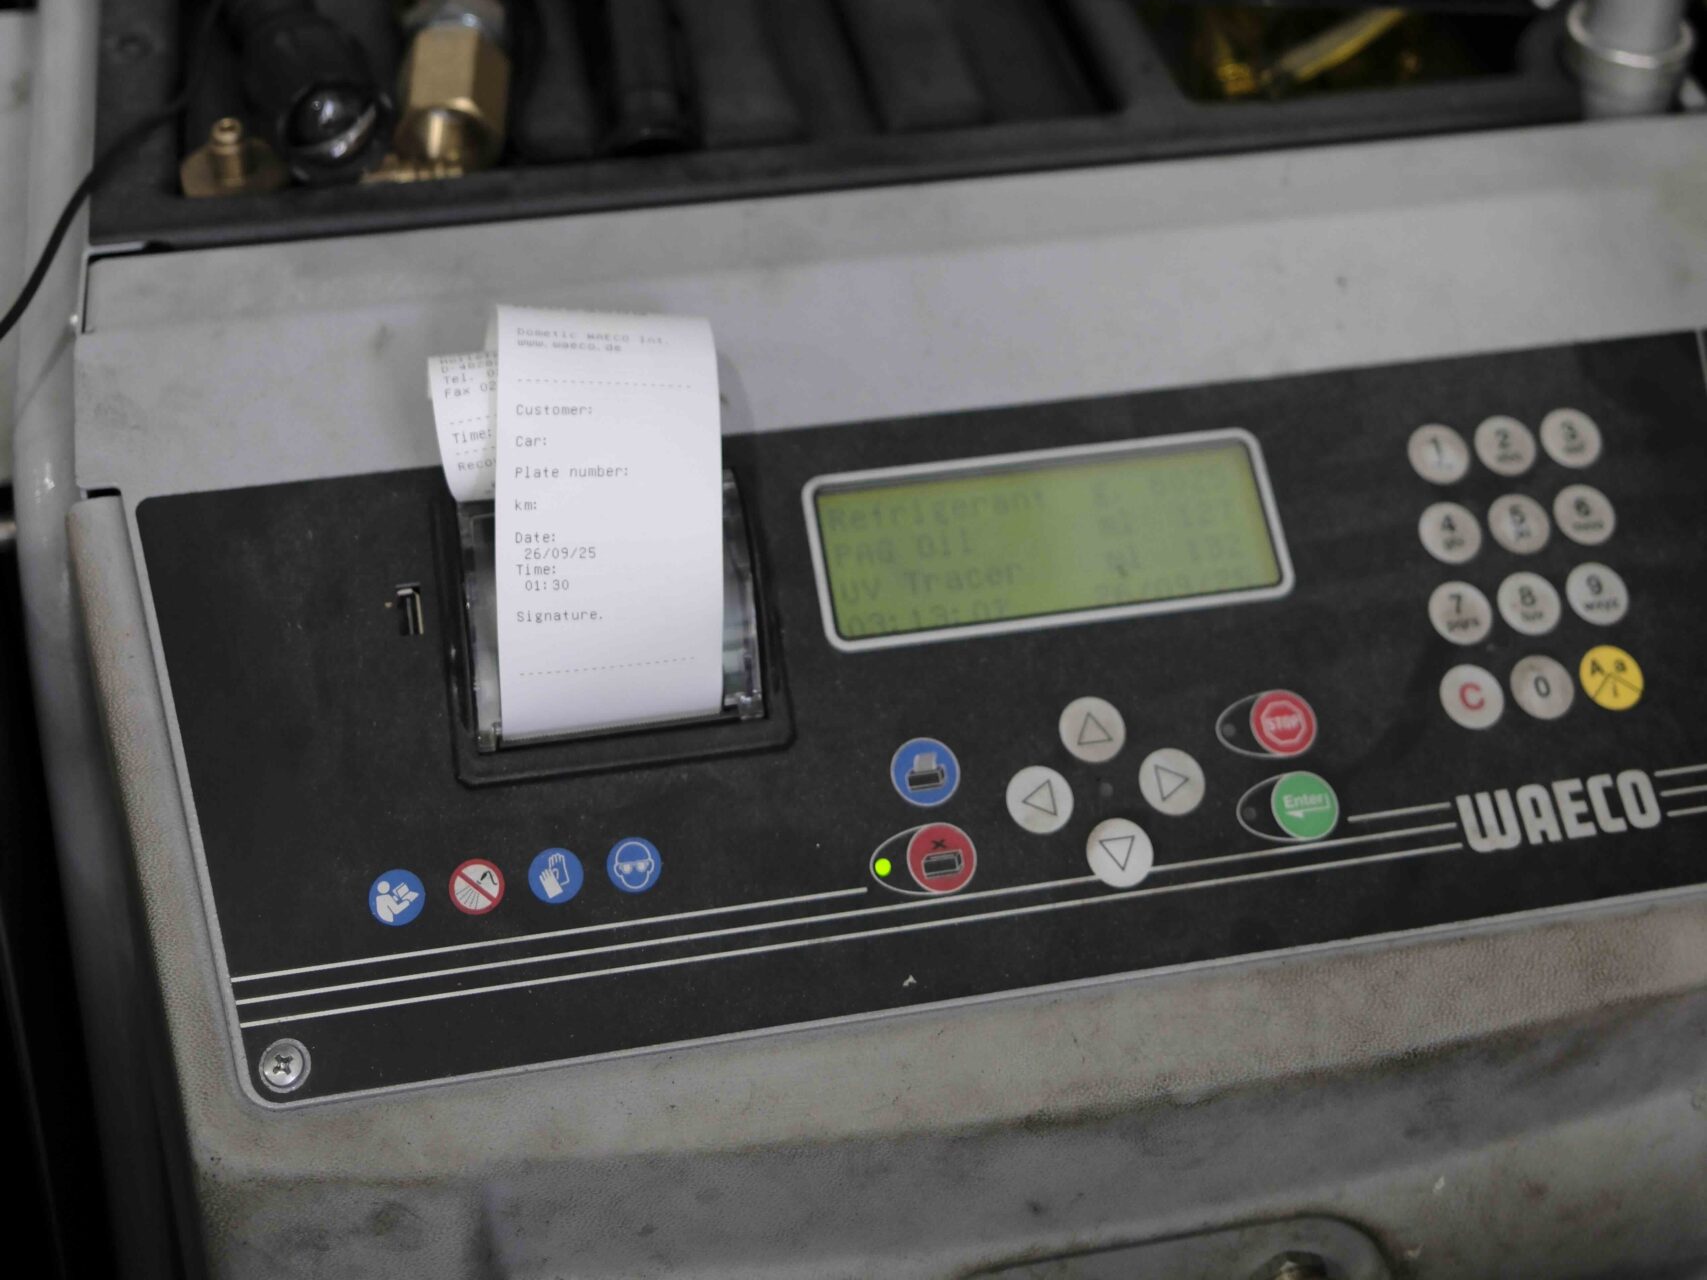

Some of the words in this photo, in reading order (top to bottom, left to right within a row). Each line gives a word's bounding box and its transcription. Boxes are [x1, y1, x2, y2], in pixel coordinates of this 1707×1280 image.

[443, 386, 471, 400] Fax
[515, 403, 593, 416] Customer:
[452, 427, 492, 444] Time:
[515, 435, 547, 447] Car:
[1494, 427, 1510, 450] 2
[514, 466, 560, 479] Plate
[569, 465, 629, 478] number:
[514, 499, 537, 512] km:
[828, 489, 1045, 532] Refrigerant
[1441, 513, 1456, 532] 4
[514, 531, 556, 544] Date:
[524, 546, 597, 560] 26/09/25
[833, 538, 895, 569] PAG
[516, 564, 556, 577] Time:
[524, 579, 570, 592] 01:30
[840, 579, 882, 603] UV
[903, 562, 1023, 595] Tracer
[1585, 573, 1603, 596] 9
[1447, 592, 1463, 616] 7
[1518, 584, 1536, 607] 8
[516, 607, 604, 624] Signature.
[1589, 657, 1606, 677] A
[1458, 680, 1486, 712] C
[1533, 675, 1552, 699] 0
[1262, 713, 1303, 732] STOP
[1282, 792, 1325, 810] Enter
[1455, 768, 1662, 854] WAECO
